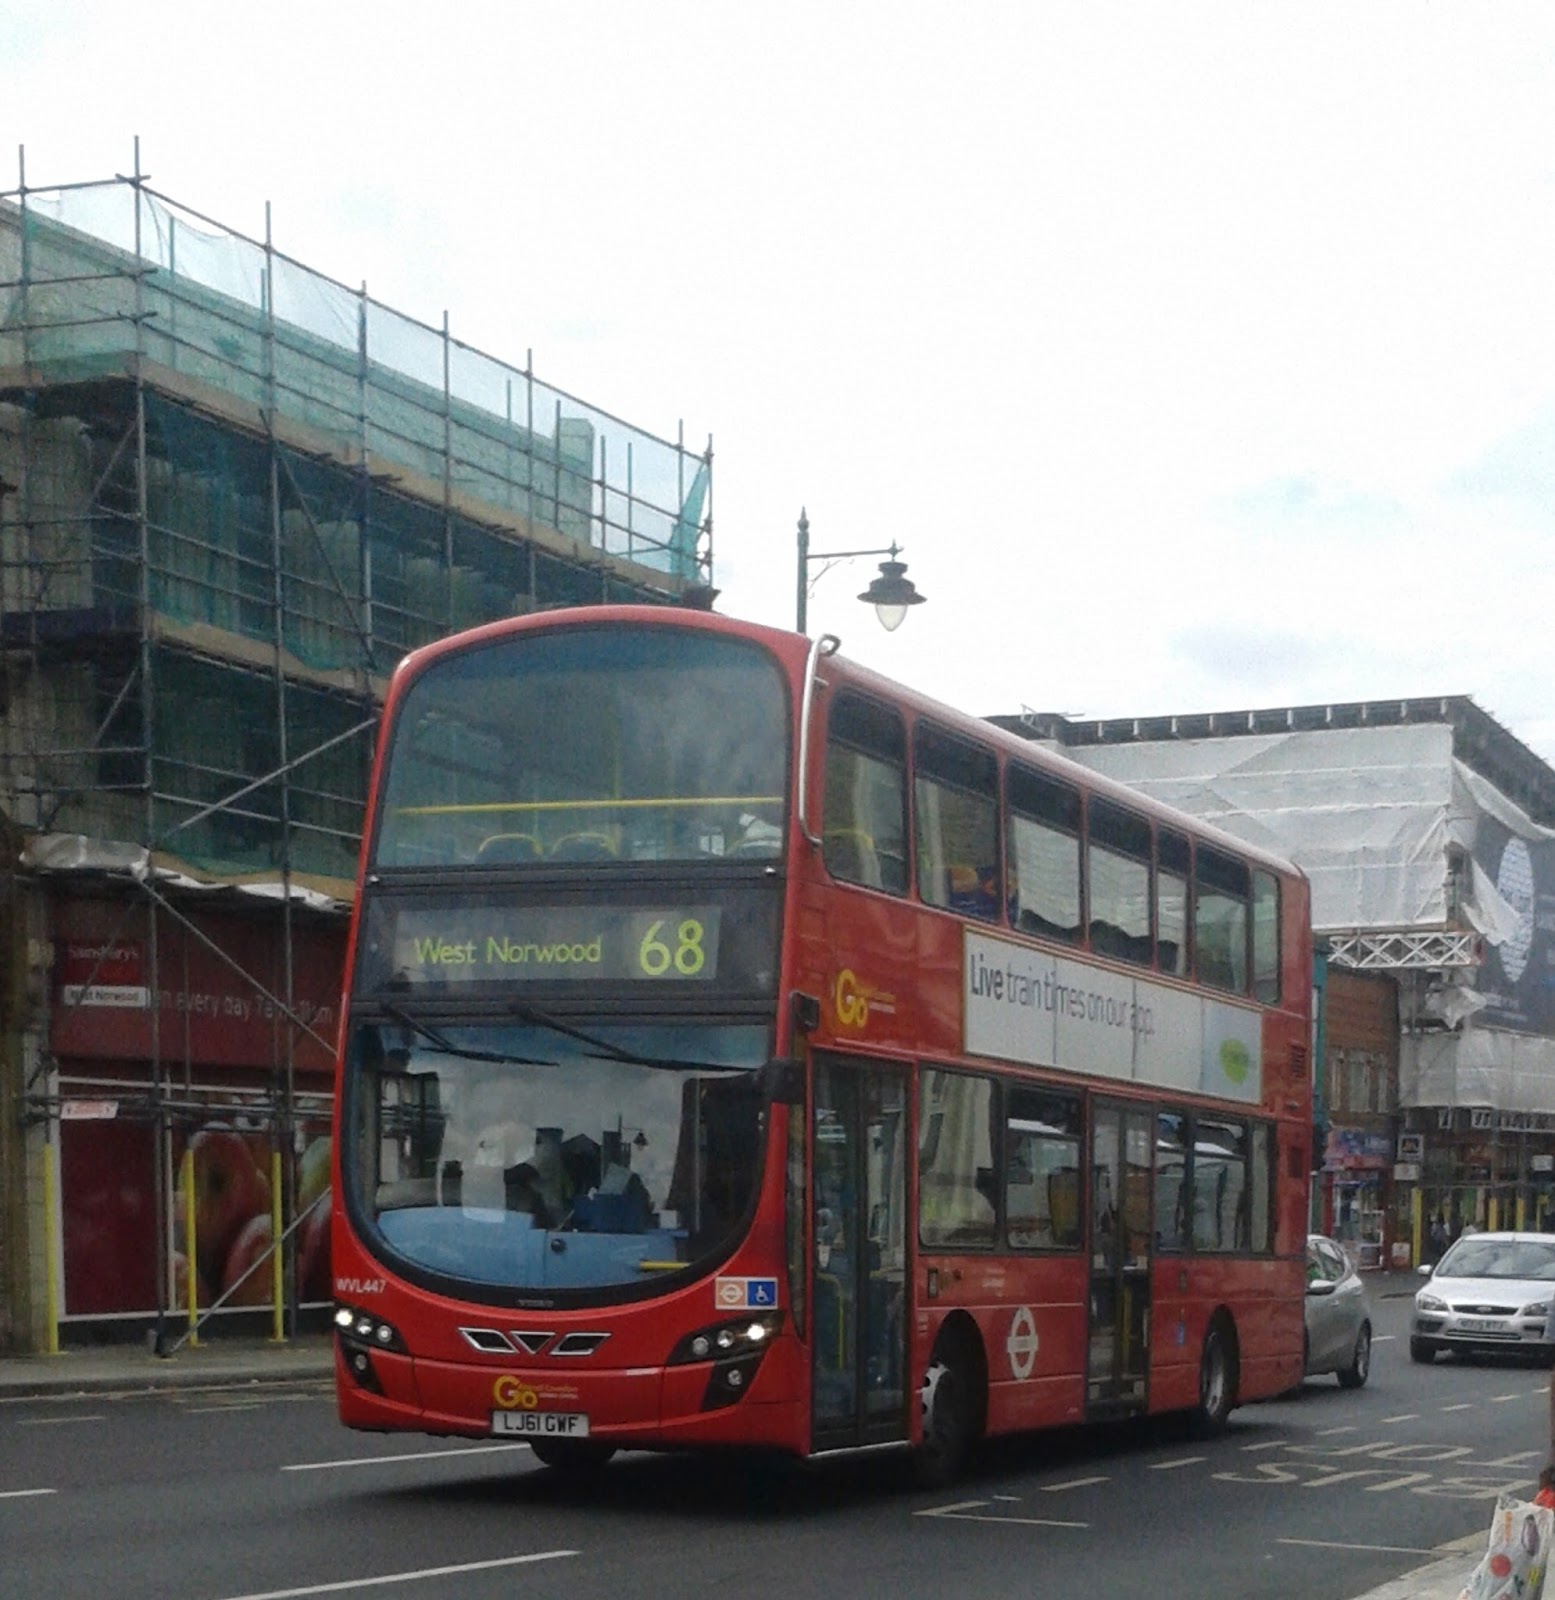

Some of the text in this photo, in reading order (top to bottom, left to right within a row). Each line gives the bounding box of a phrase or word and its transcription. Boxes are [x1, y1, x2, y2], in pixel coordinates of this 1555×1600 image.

[414, 918, 706, 976] West Norwood 68
[224, 994, 251, 1022] day
[836, 968, 869, 1029] Go
[969, 953, 1004, 1001] Live
[1006, 963, 1042, 1010] train
[1043, 971, 1086, 1020] times
[1087, 992, 1104, 1023] on
[1105, 996, 1126, 1028] our
[336, 1277, 386, 1293] WVL447
[493, 1374, 538, 1409] Go
[503, 1413, 579, 1433] LJ61 GWF
[1284, 1440, 1543, 1470] TOP
[1211, 1461, 1538, 1500] BUS
